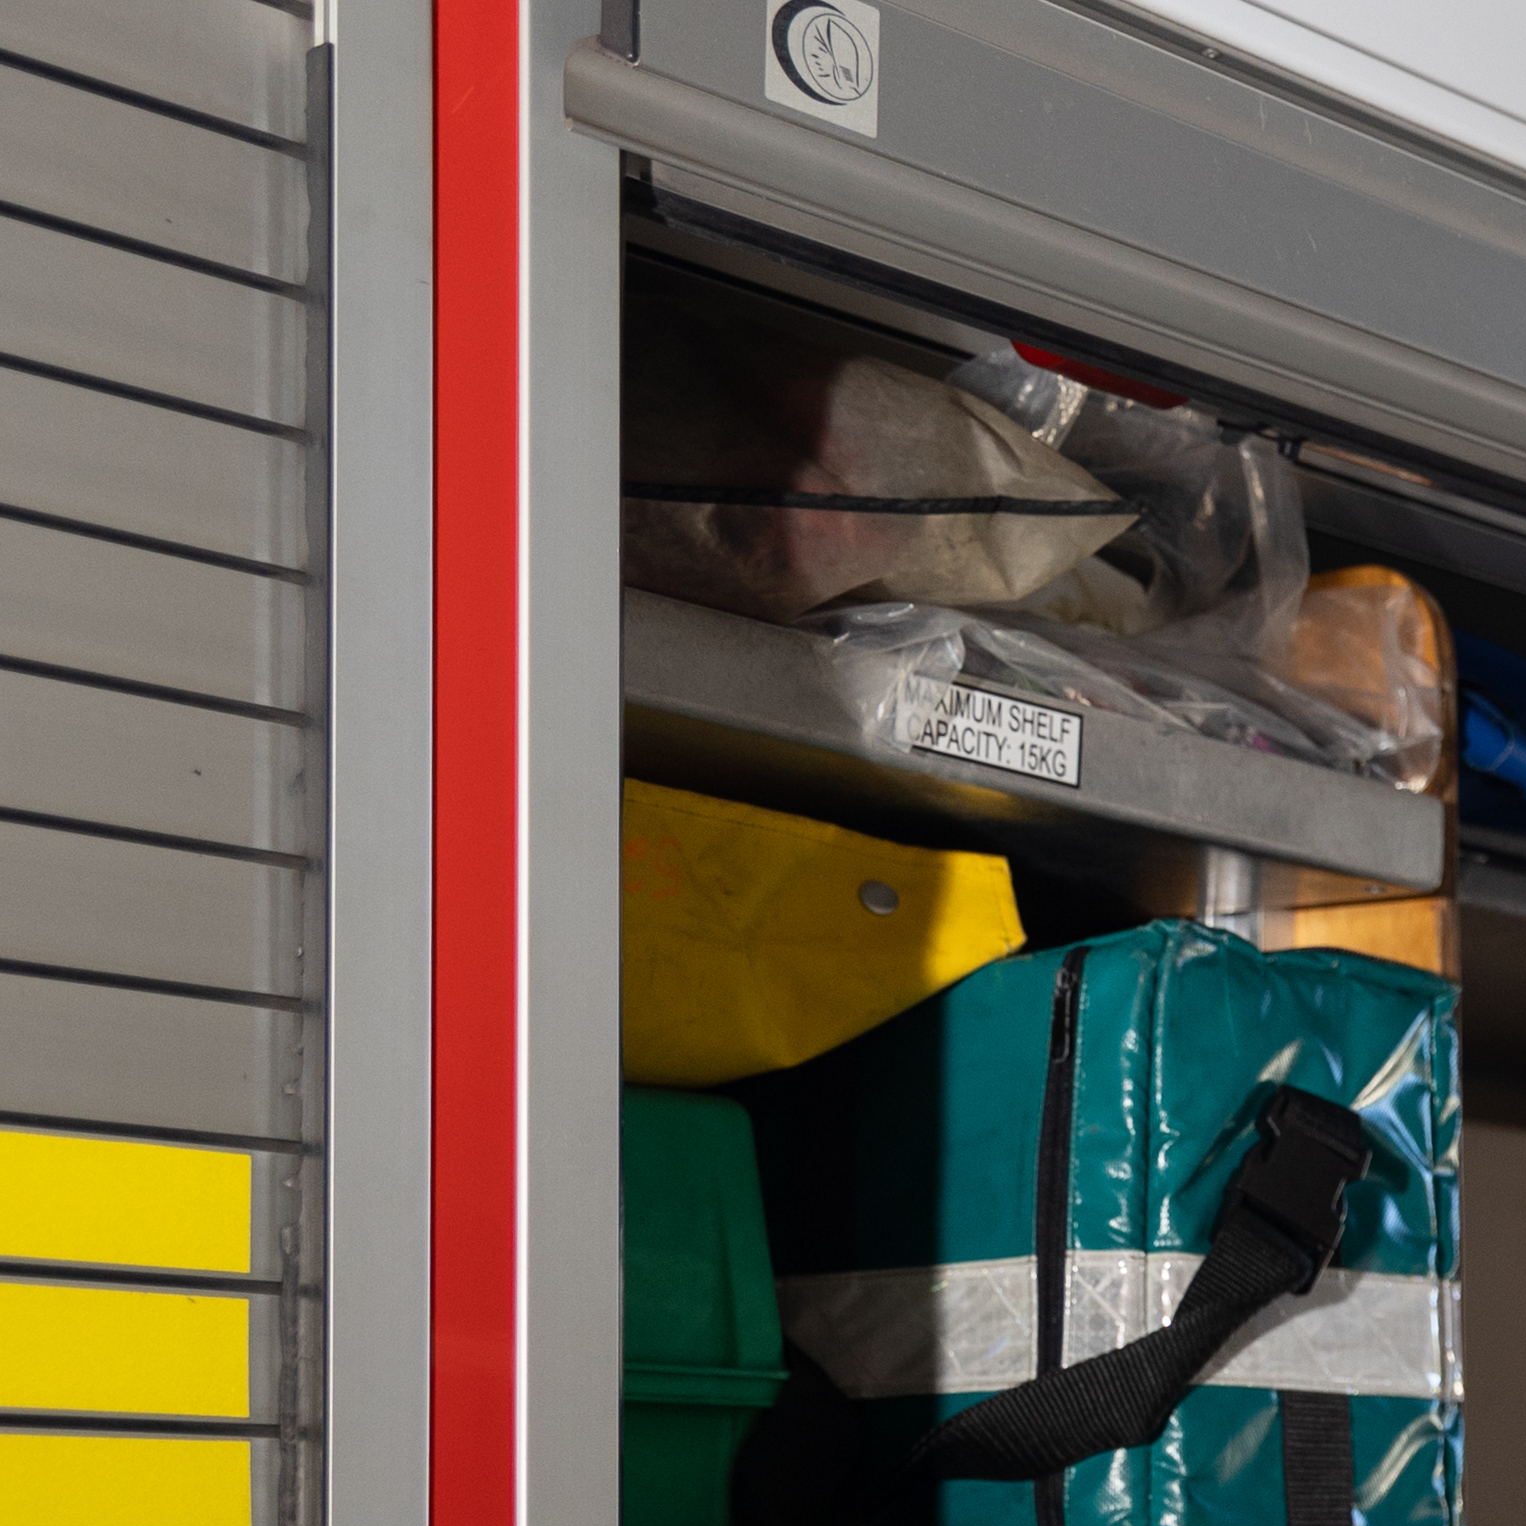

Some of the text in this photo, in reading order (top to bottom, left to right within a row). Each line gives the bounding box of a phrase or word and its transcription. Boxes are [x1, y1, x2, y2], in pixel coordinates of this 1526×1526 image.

[906, 712, 1067, 778] CAPACITY: 15KG
[1008, 705, 1071, 744] SHELF
